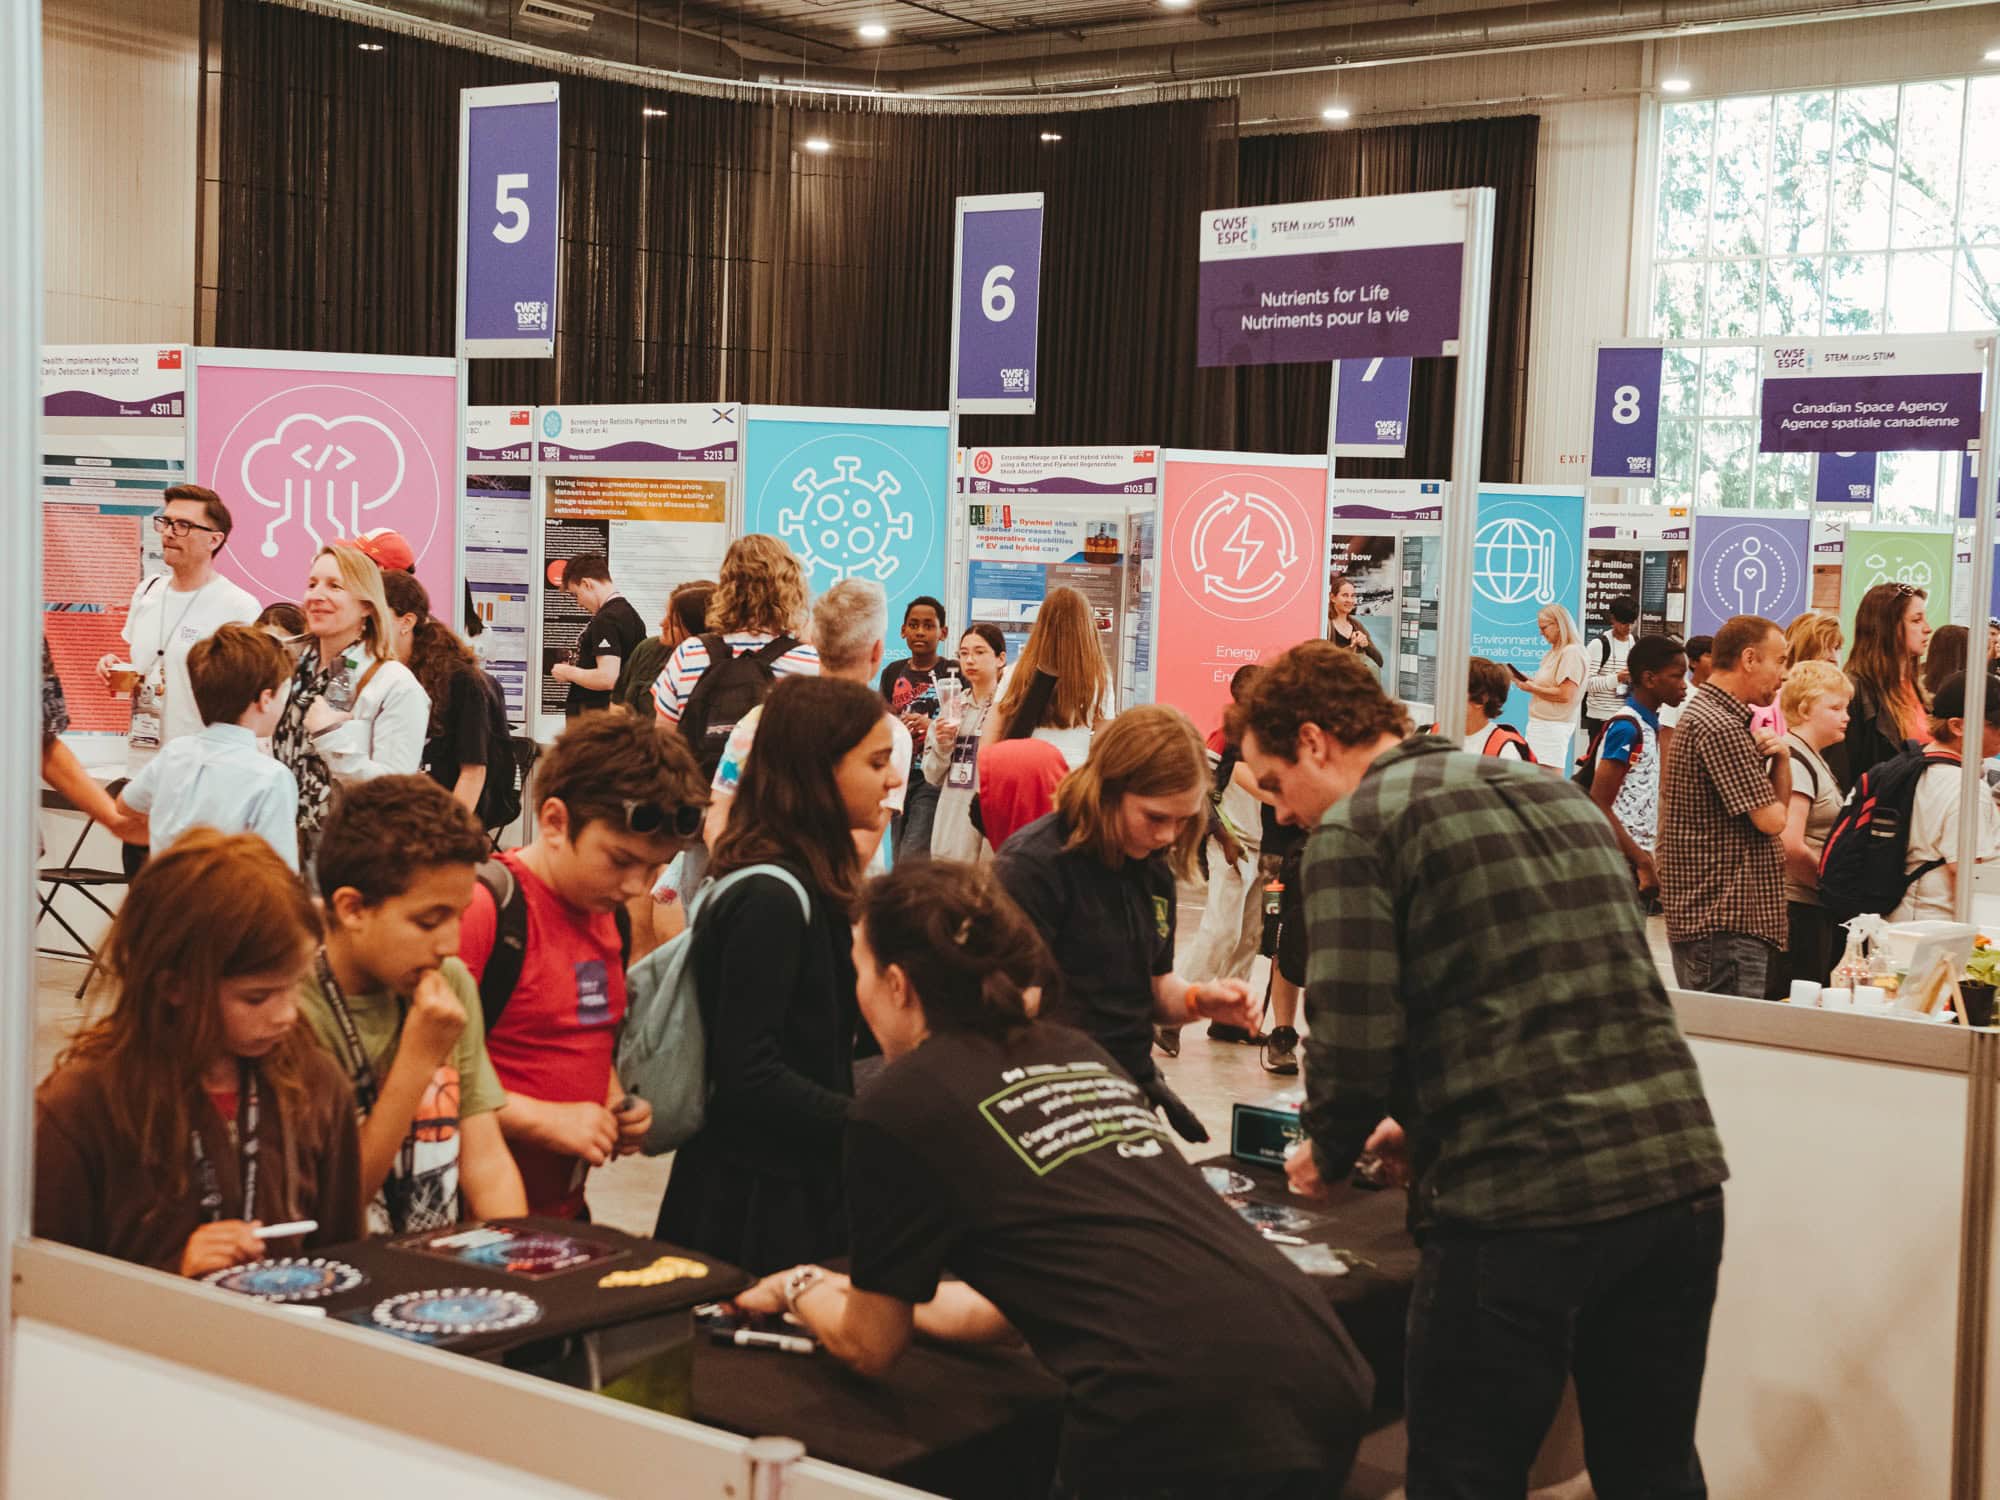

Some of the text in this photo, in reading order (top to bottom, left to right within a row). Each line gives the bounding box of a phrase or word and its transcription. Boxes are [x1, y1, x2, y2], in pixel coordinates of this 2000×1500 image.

[492, 174, 530, 244] 5
[1213, 216, 1248, 231] CWSF
[1272, 221, 1300, 232] STEM
[1328, 216, 1355, 228] STIM
[1218, 230, 1248, 244] ESPC
[982, 265, 1016, 322] 6
[1261, 284, 1390, 308] Nutrients for Life
[514, 302, 541, 313] CWSF
[518, 313, 540, 324] ESPC
[1241, 308, 1410, 331] Nutriments pour la vie
[1774, 348, 1804, 358] CWSF
[1778, 359, 1804, 368] ESPC
[1000, 369, 1024, 378] CWSF
[1004, 378, 1024, 387] ESPC
[150, 403, 170, 416] 4311
[1612, 385, 1641, 424] 8
[1792, 400, 1948, 414] Canadian Space Agency
[1781, 416, 1960, 430] Agence spatiale canadienne
[704, 450, 723, 460] 5213
[1560, 454, 1586, 464] EXIT
[555, 480, 576, 488] Using
[1124, 484, 1144, 493] 6103
[1602, 561, 1633, 569] million
[1592, 571, 1624, 579] marine
[1472, 634, 1537, 646] Environment
[1216, 645, 1260, 660] Energy
